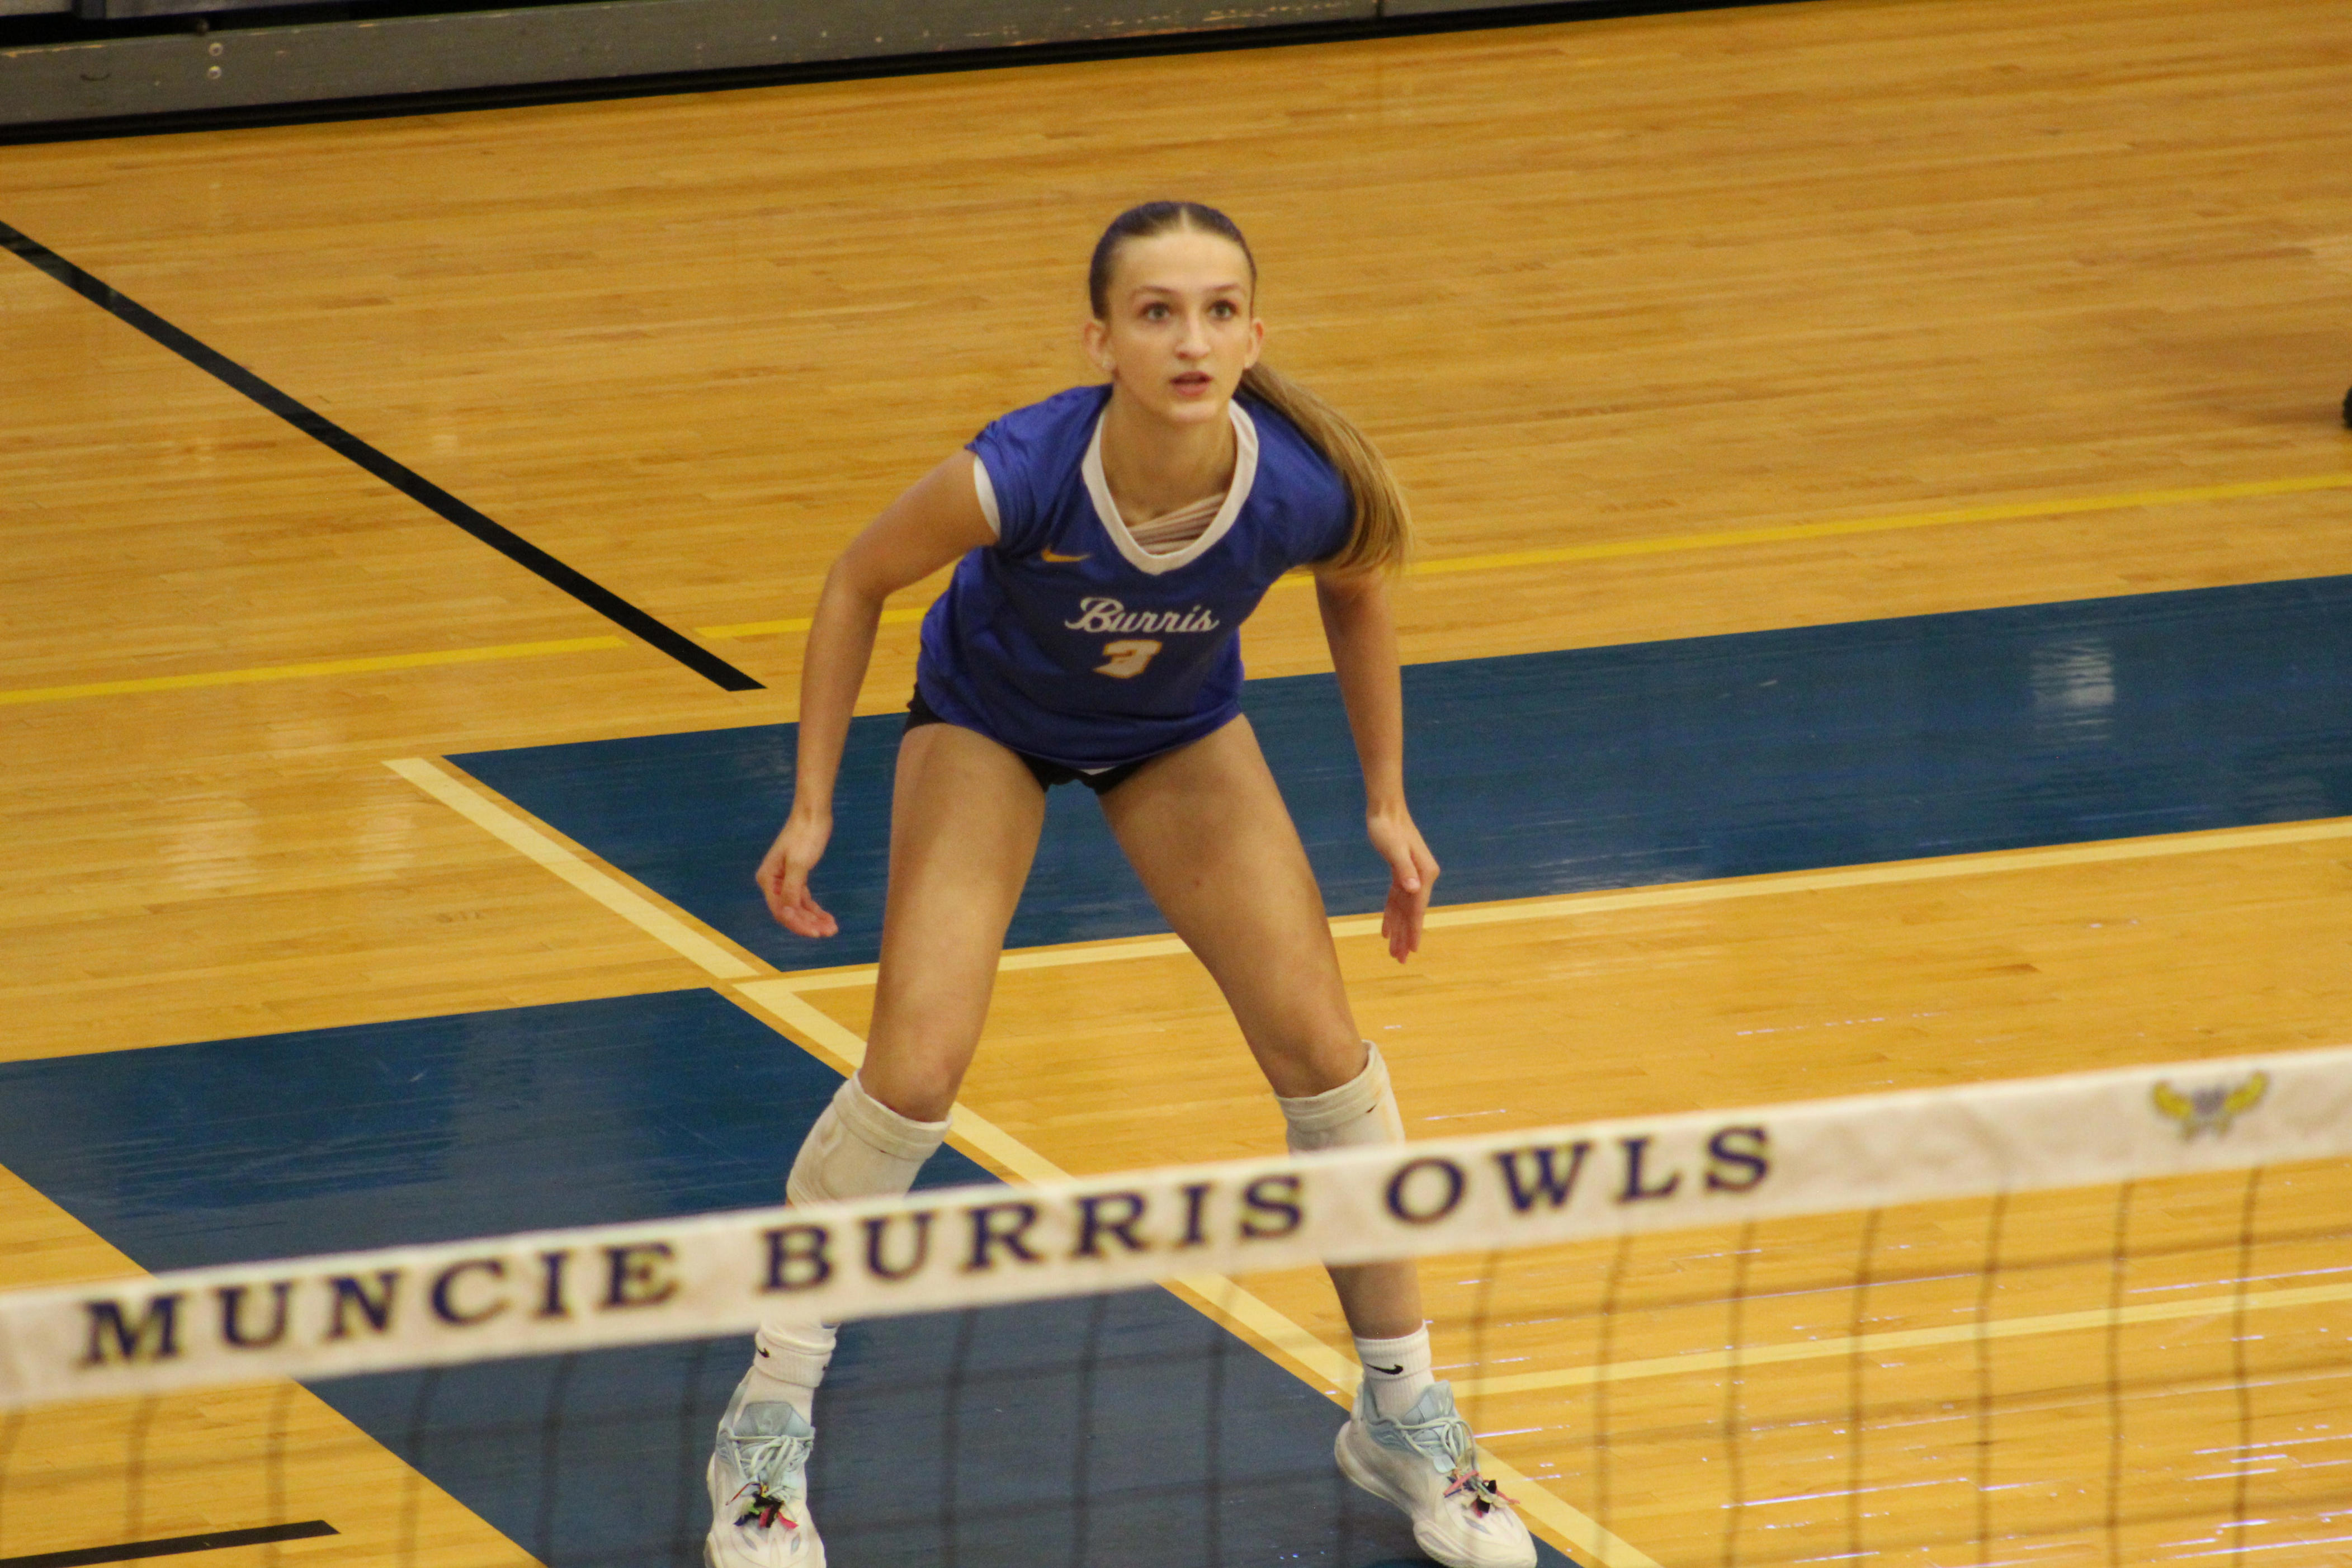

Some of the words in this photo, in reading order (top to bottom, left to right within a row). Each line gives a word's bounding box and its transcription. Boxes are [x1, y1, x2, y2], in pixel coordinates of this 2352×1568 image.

[1065, 597, 1220, 633] Burris
[78, 1243, 681, 1367] MUNCIE
[755, 1173, 1305, 1295] BURRIS
[1384, 1125, 1772, 1226] OWLS
